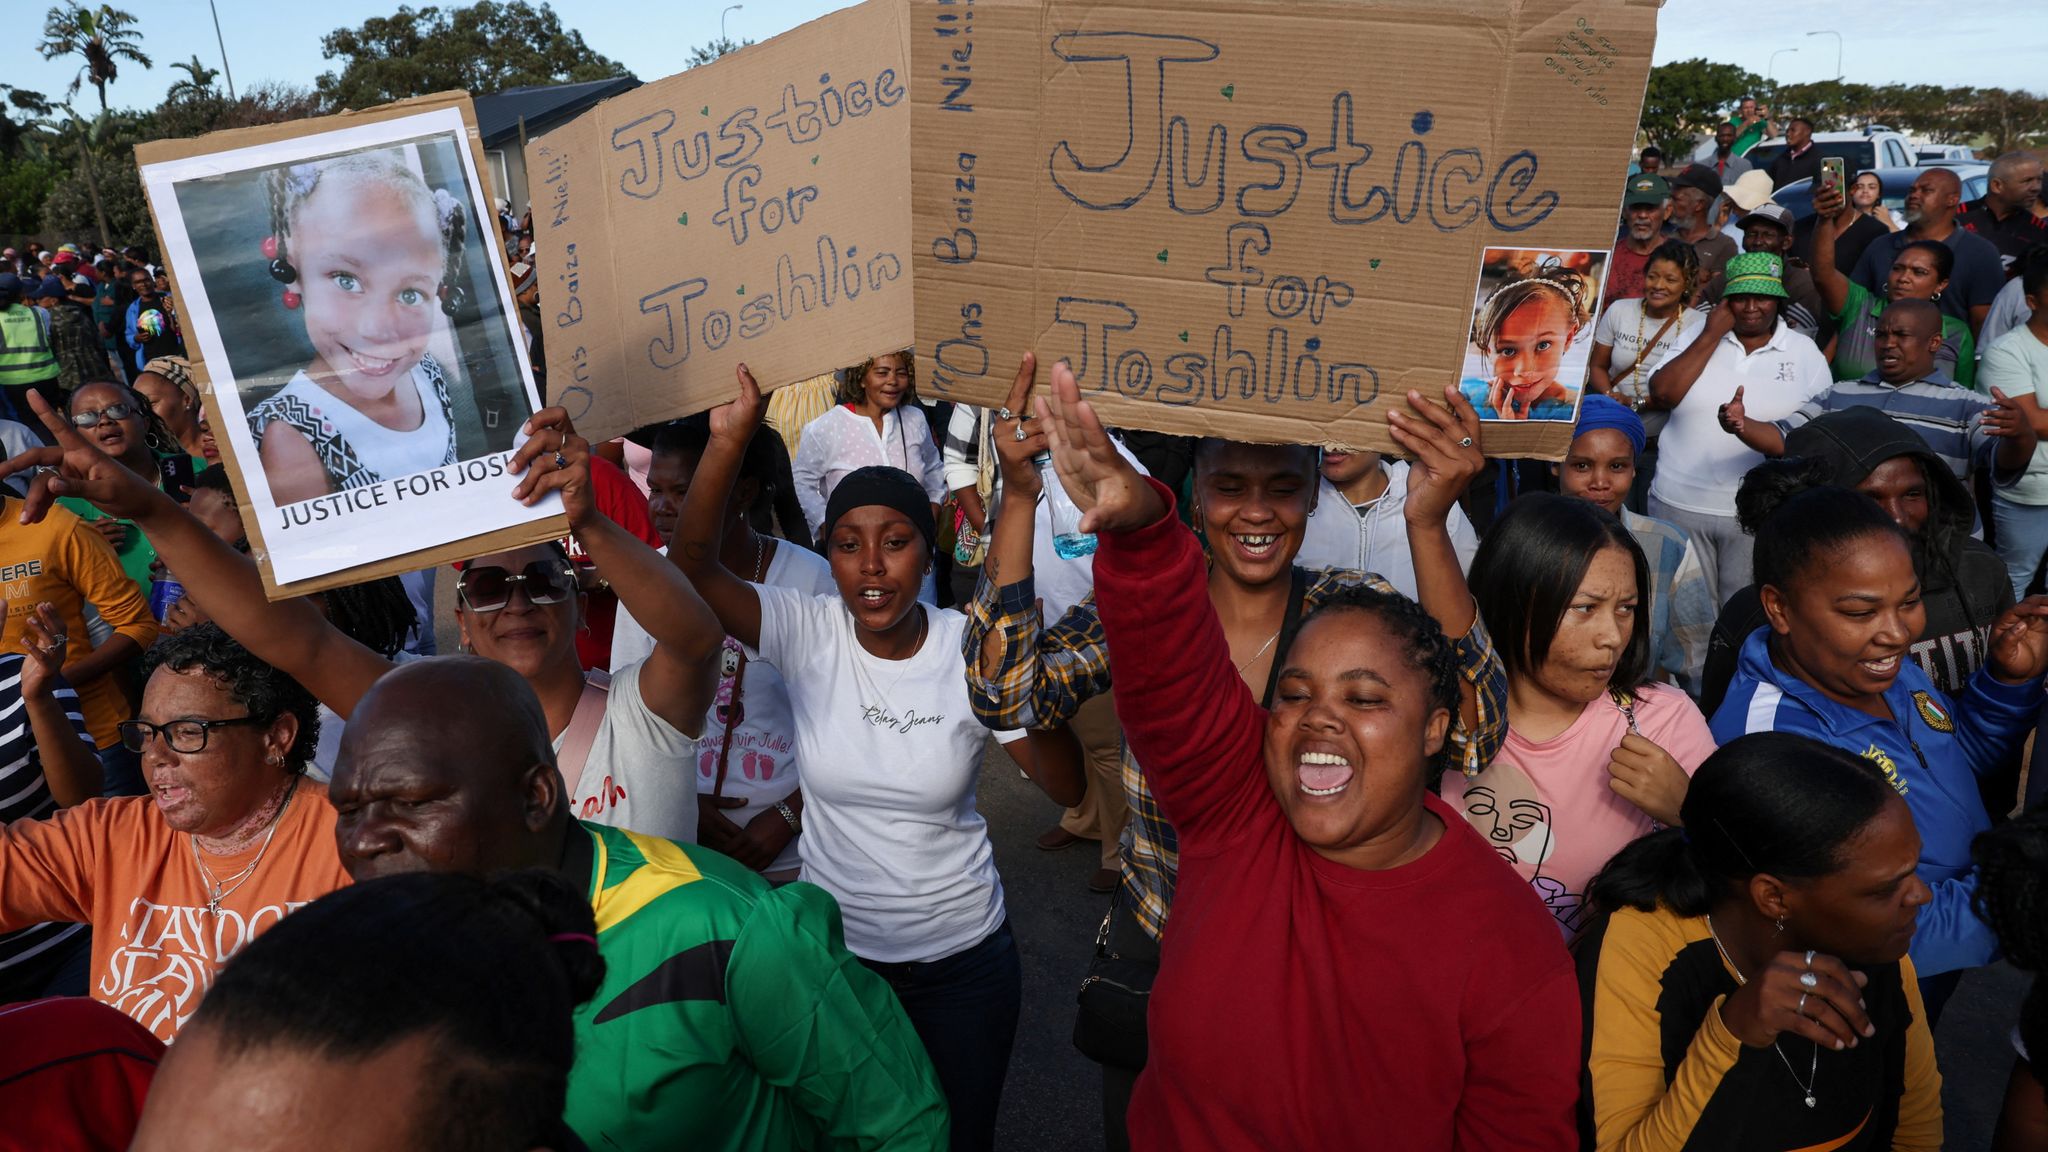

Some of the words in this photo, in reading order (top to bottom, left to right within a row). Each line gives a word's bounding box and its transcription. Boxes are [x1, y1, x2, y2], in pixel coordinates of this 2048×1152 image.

[610, 67, 905, 199] Justice
[1050, 30, 1560, 232] Justice
[712, 163, 819, 246] for
[932, 151, 977, 264] Baiza
[557, 243, 583, 328] Baiza
[639, 234, 902, 370] Joshlin
[1205, 221, 1354, 325] for
[1053, 296, 1380, 406] Joshlin
[281, 485, 388, 529] JUSTICE
[393, 469, 451, 501] FOR
[457, 453, 510, 487] JOS
[736, 732, 756, 746] vir
[860, 704, 901, 730] Relay
[899, 710, 946, 734] Jeans
